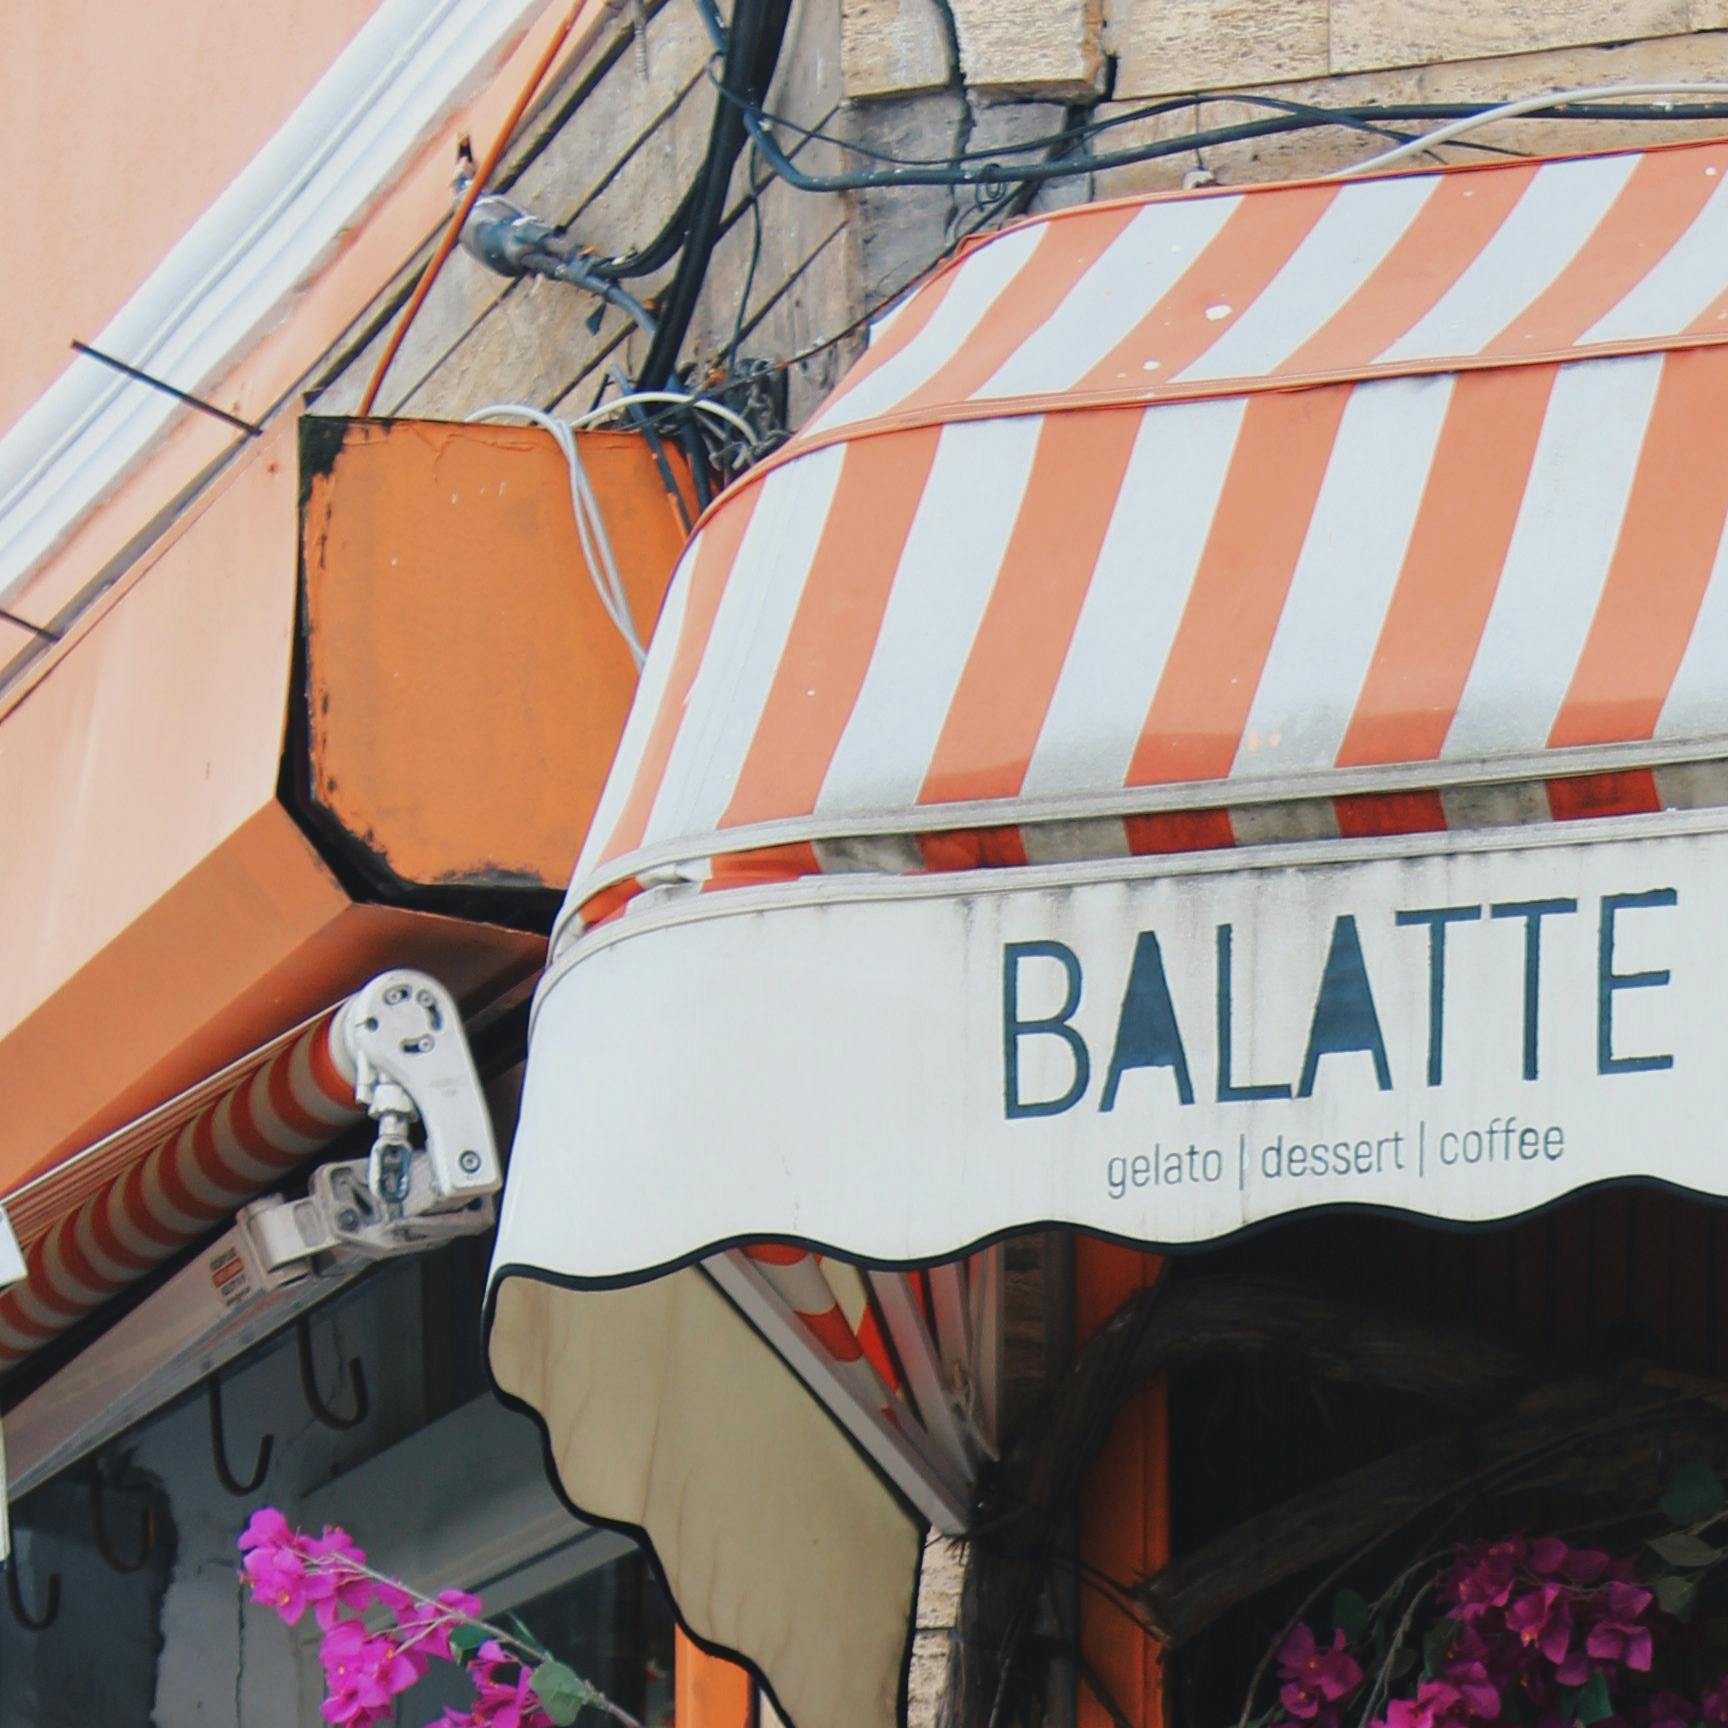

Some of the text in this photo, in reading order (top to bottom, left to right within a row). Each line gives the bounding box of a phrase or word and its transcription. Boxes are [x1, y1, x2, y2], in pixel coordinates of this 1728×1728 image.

[1002, 887, 1679, 1120] BALATTE
[1106, 1143, 1224, 1200] gelato
[1261, 1130, 1406, 1179] dessert
[1439, 1116, 1565, 1167] coffee
